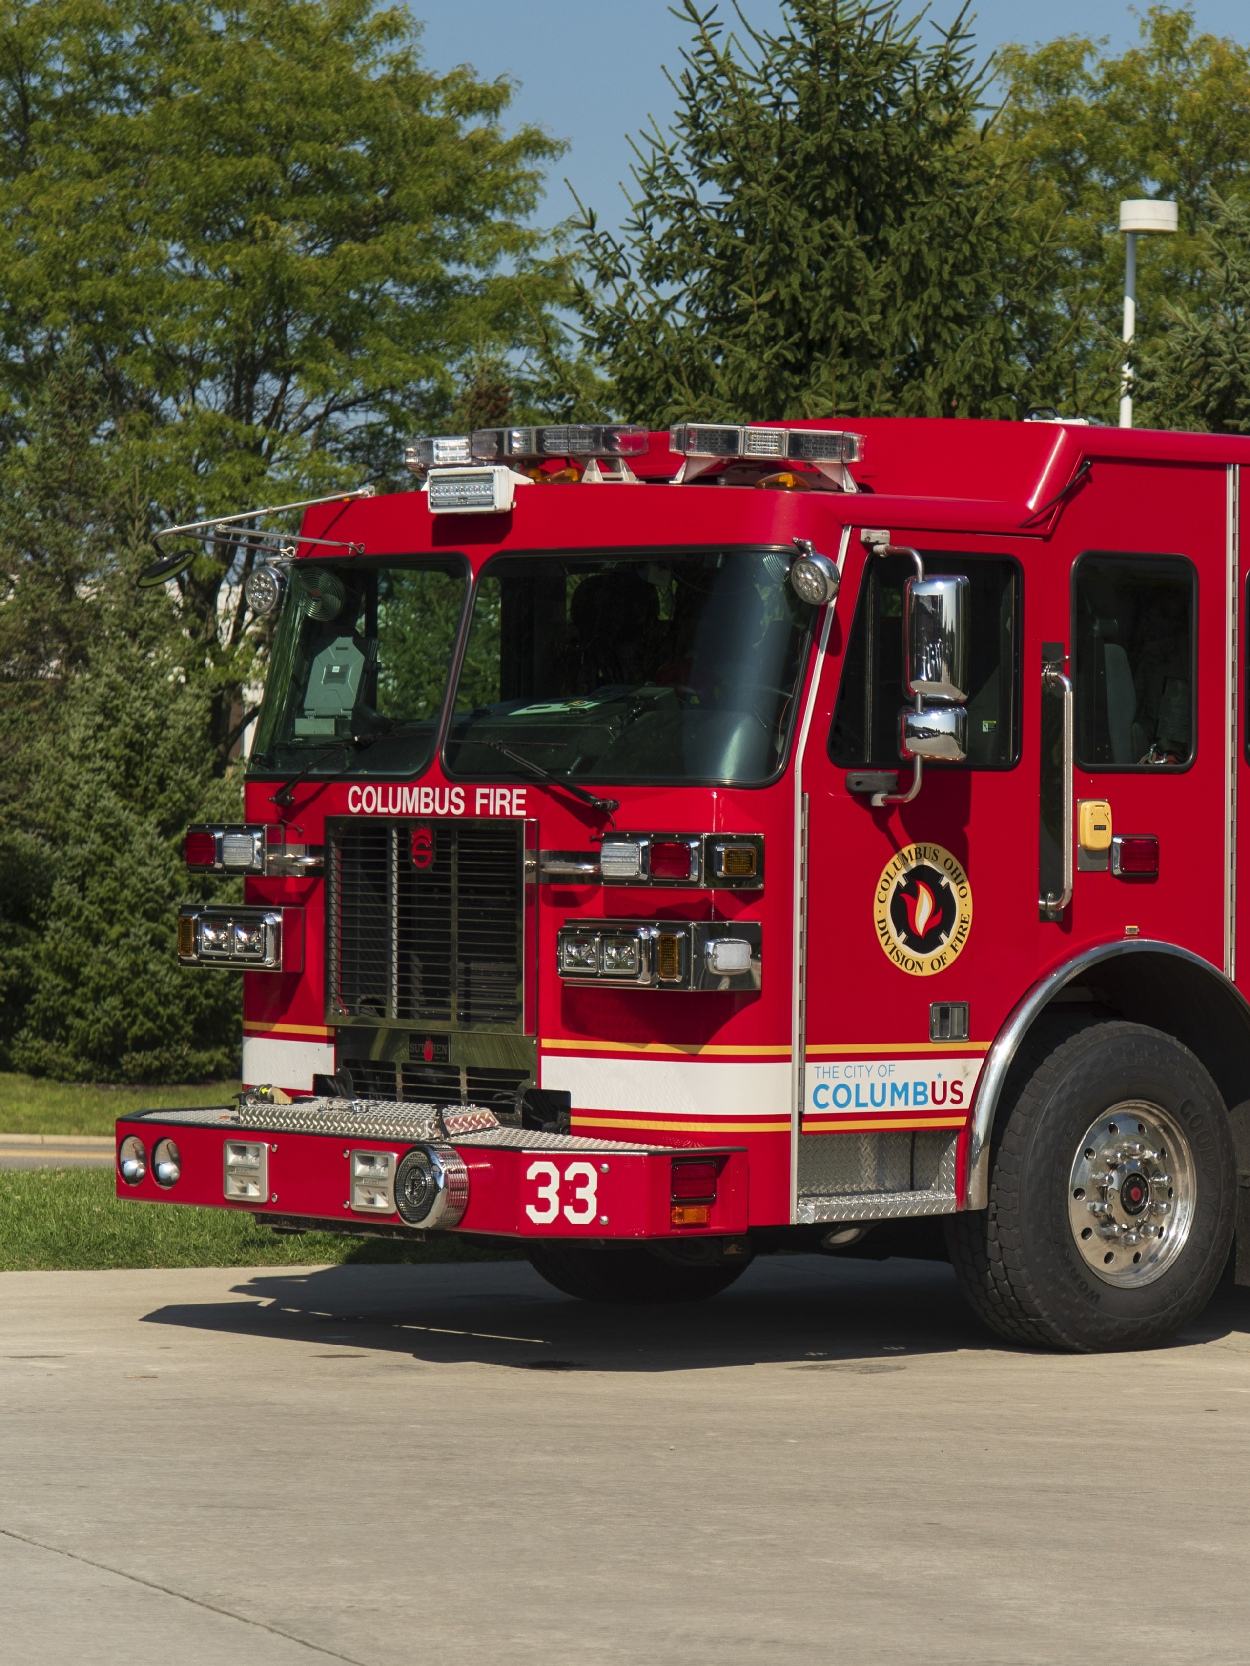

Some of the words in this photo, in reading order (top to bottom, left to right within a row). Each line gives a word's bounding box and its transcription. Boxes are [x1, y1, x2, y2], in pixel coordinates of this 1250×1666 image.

[348, 786, 465, 815] COLUMBUS
[475, 788, 527, 816] FIRE
[877, 846, 940, 904] COLUMBUS
[943, 857, 968, 899] OHIO
[877, 918, 925, 973] DIVISION
[930, 952, 947, 971] OF
[950, 913, 970, 953] FIRE
[814, 1066, 840, 1079] THE
[844, 1064, 873, 1078] CITY
[877, 1064, 896, 1077] OF
[812, 1079, 964, 1109] COLUMBUS
[525, 1161, 598, 1225] 33
